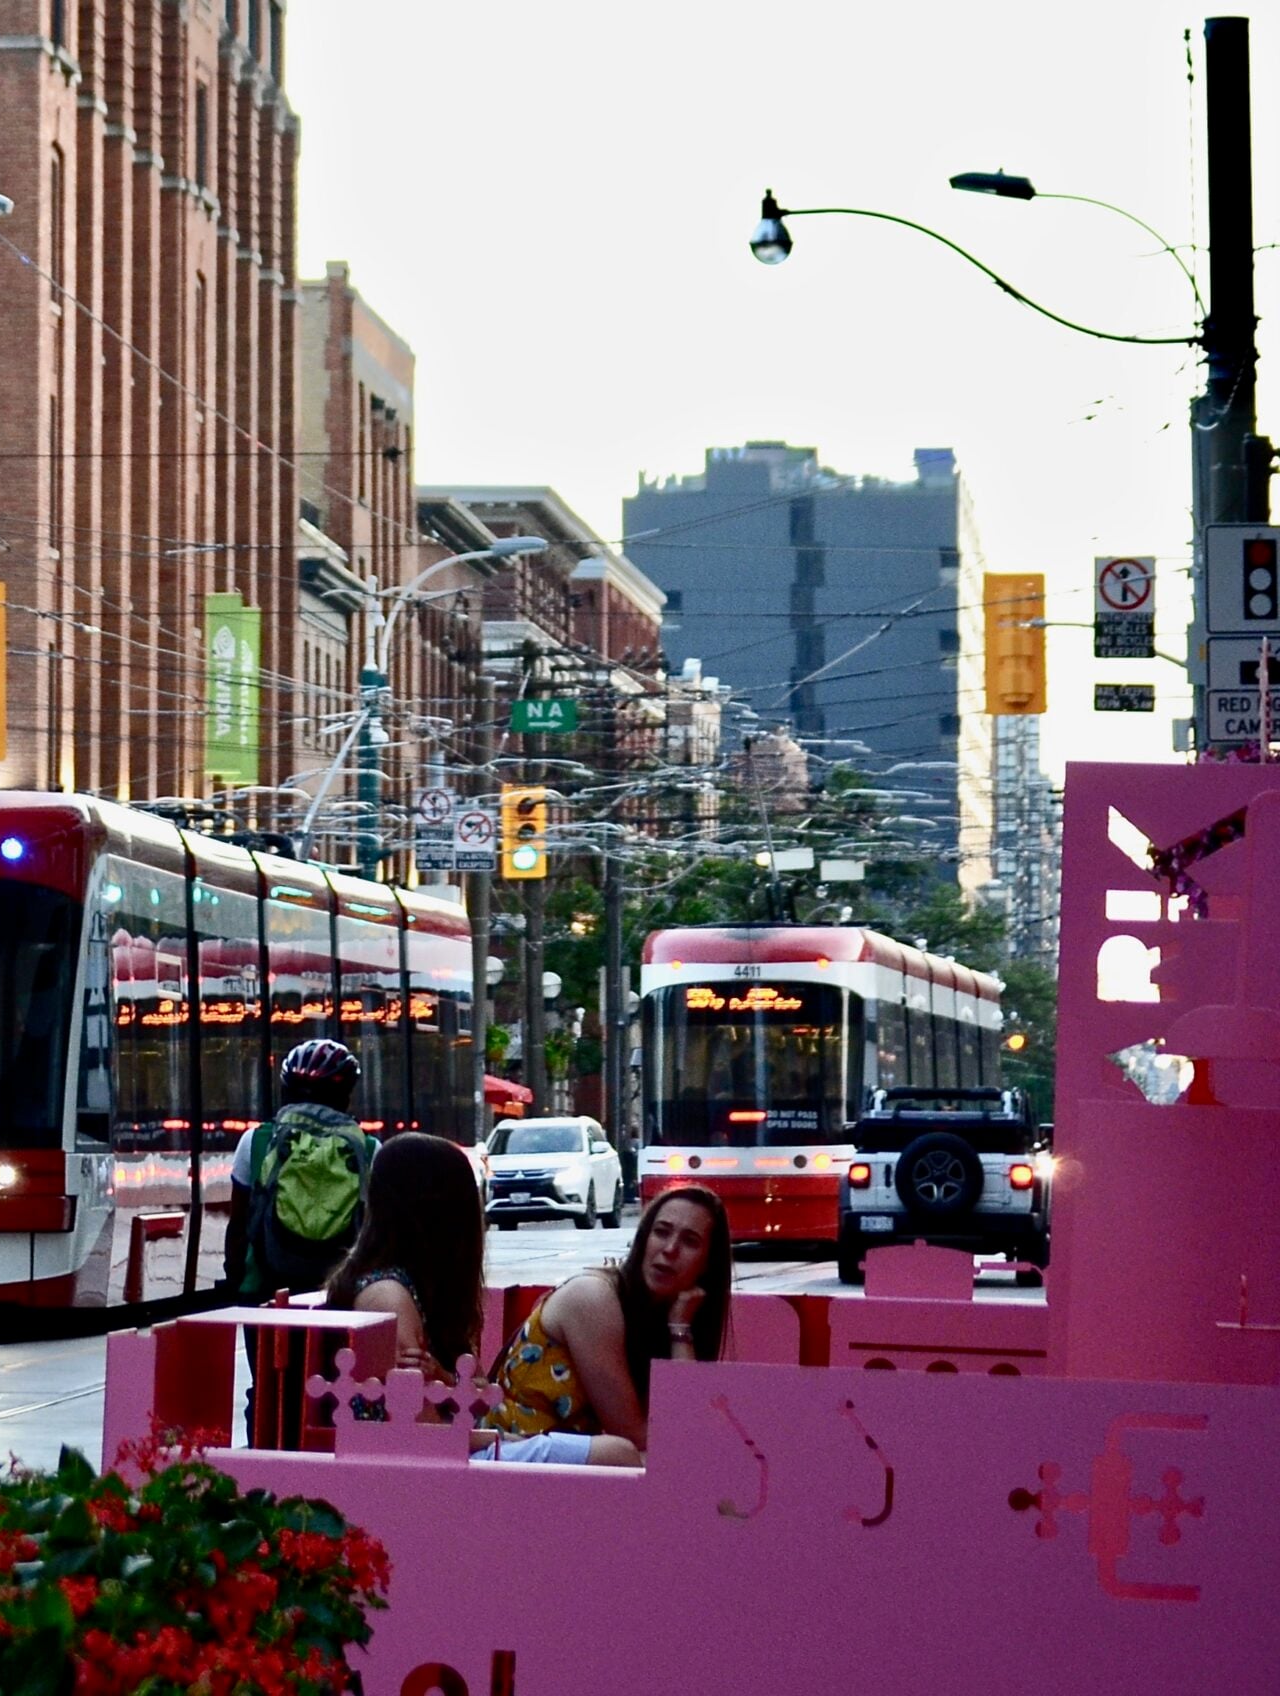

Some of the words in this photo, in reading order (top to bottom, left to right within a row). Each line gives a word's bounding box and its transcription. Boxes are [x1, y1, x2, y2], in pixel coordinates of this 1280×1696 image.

[1100, 647, 1148, 656] EXCEPTED
[1218, 697, 1251, 712] RED
[734, 966, 761, 977] 4411
[767, 1110, 778, 1118] DO
[781, 1110, 796, 1118] NOT
[798, 1111, 818, 1119] PASS
[767, 1120, 789, 1128] OPEN
[791, 1121, 818, 1129] DOORS
